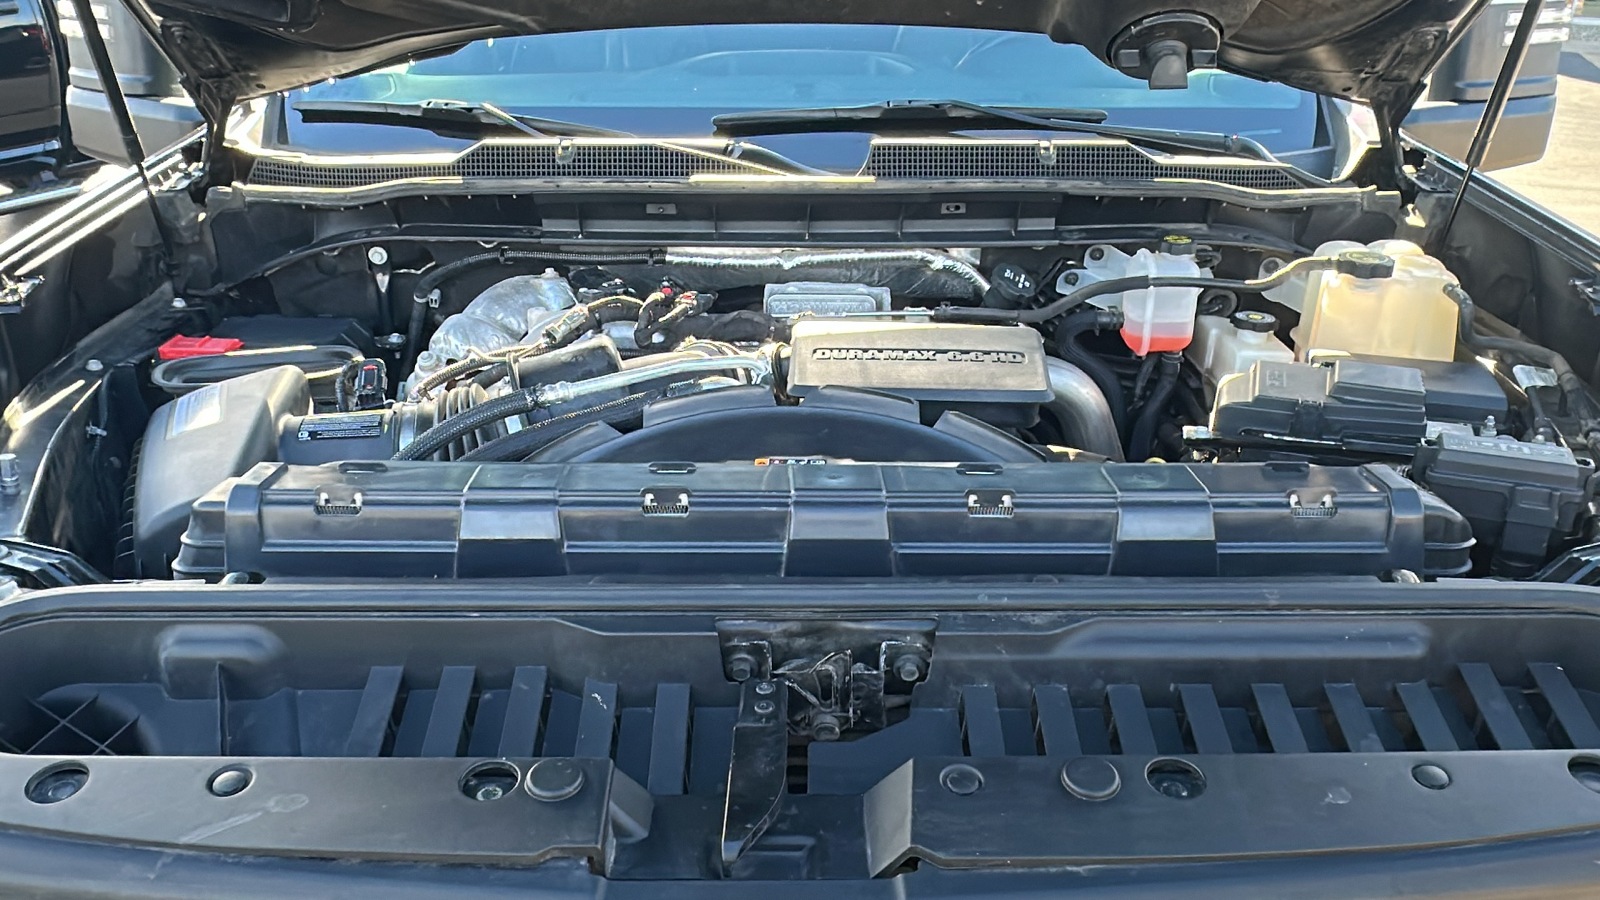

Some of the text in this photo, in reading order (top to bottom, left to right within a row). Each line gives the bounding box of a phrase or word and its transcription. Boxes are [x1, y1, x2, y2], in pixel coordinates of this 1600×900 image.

[815, 349, 1024, 363] DURAMAX 6.6 HD
